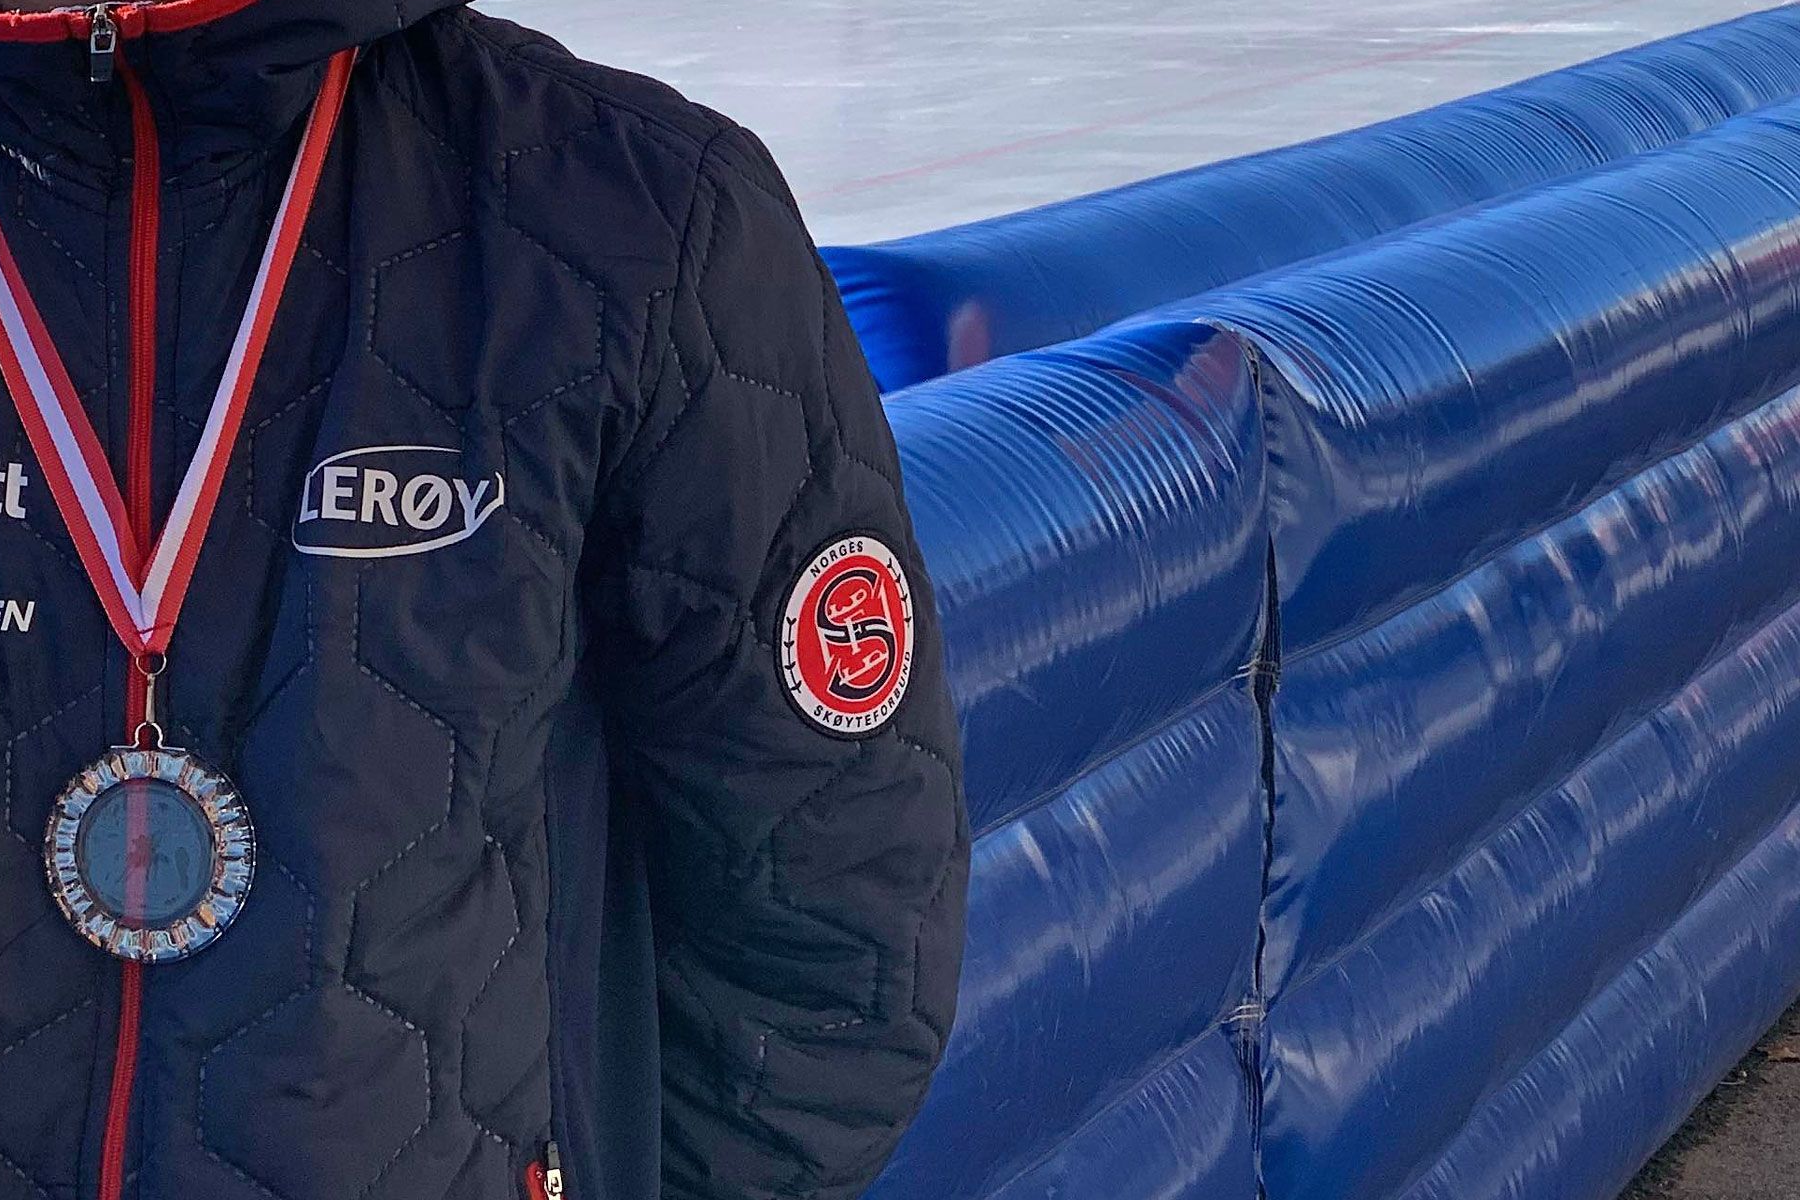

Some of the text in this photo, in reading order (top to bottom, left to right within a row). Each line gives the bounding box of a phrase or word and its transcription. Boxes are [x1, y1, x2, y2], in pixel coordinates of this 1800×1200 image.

[299, 466, 490, 531] LERØY
[810, 540, 864, 578] NORGES
[813, 651, 911, 729] SKØYTEFORBUND
